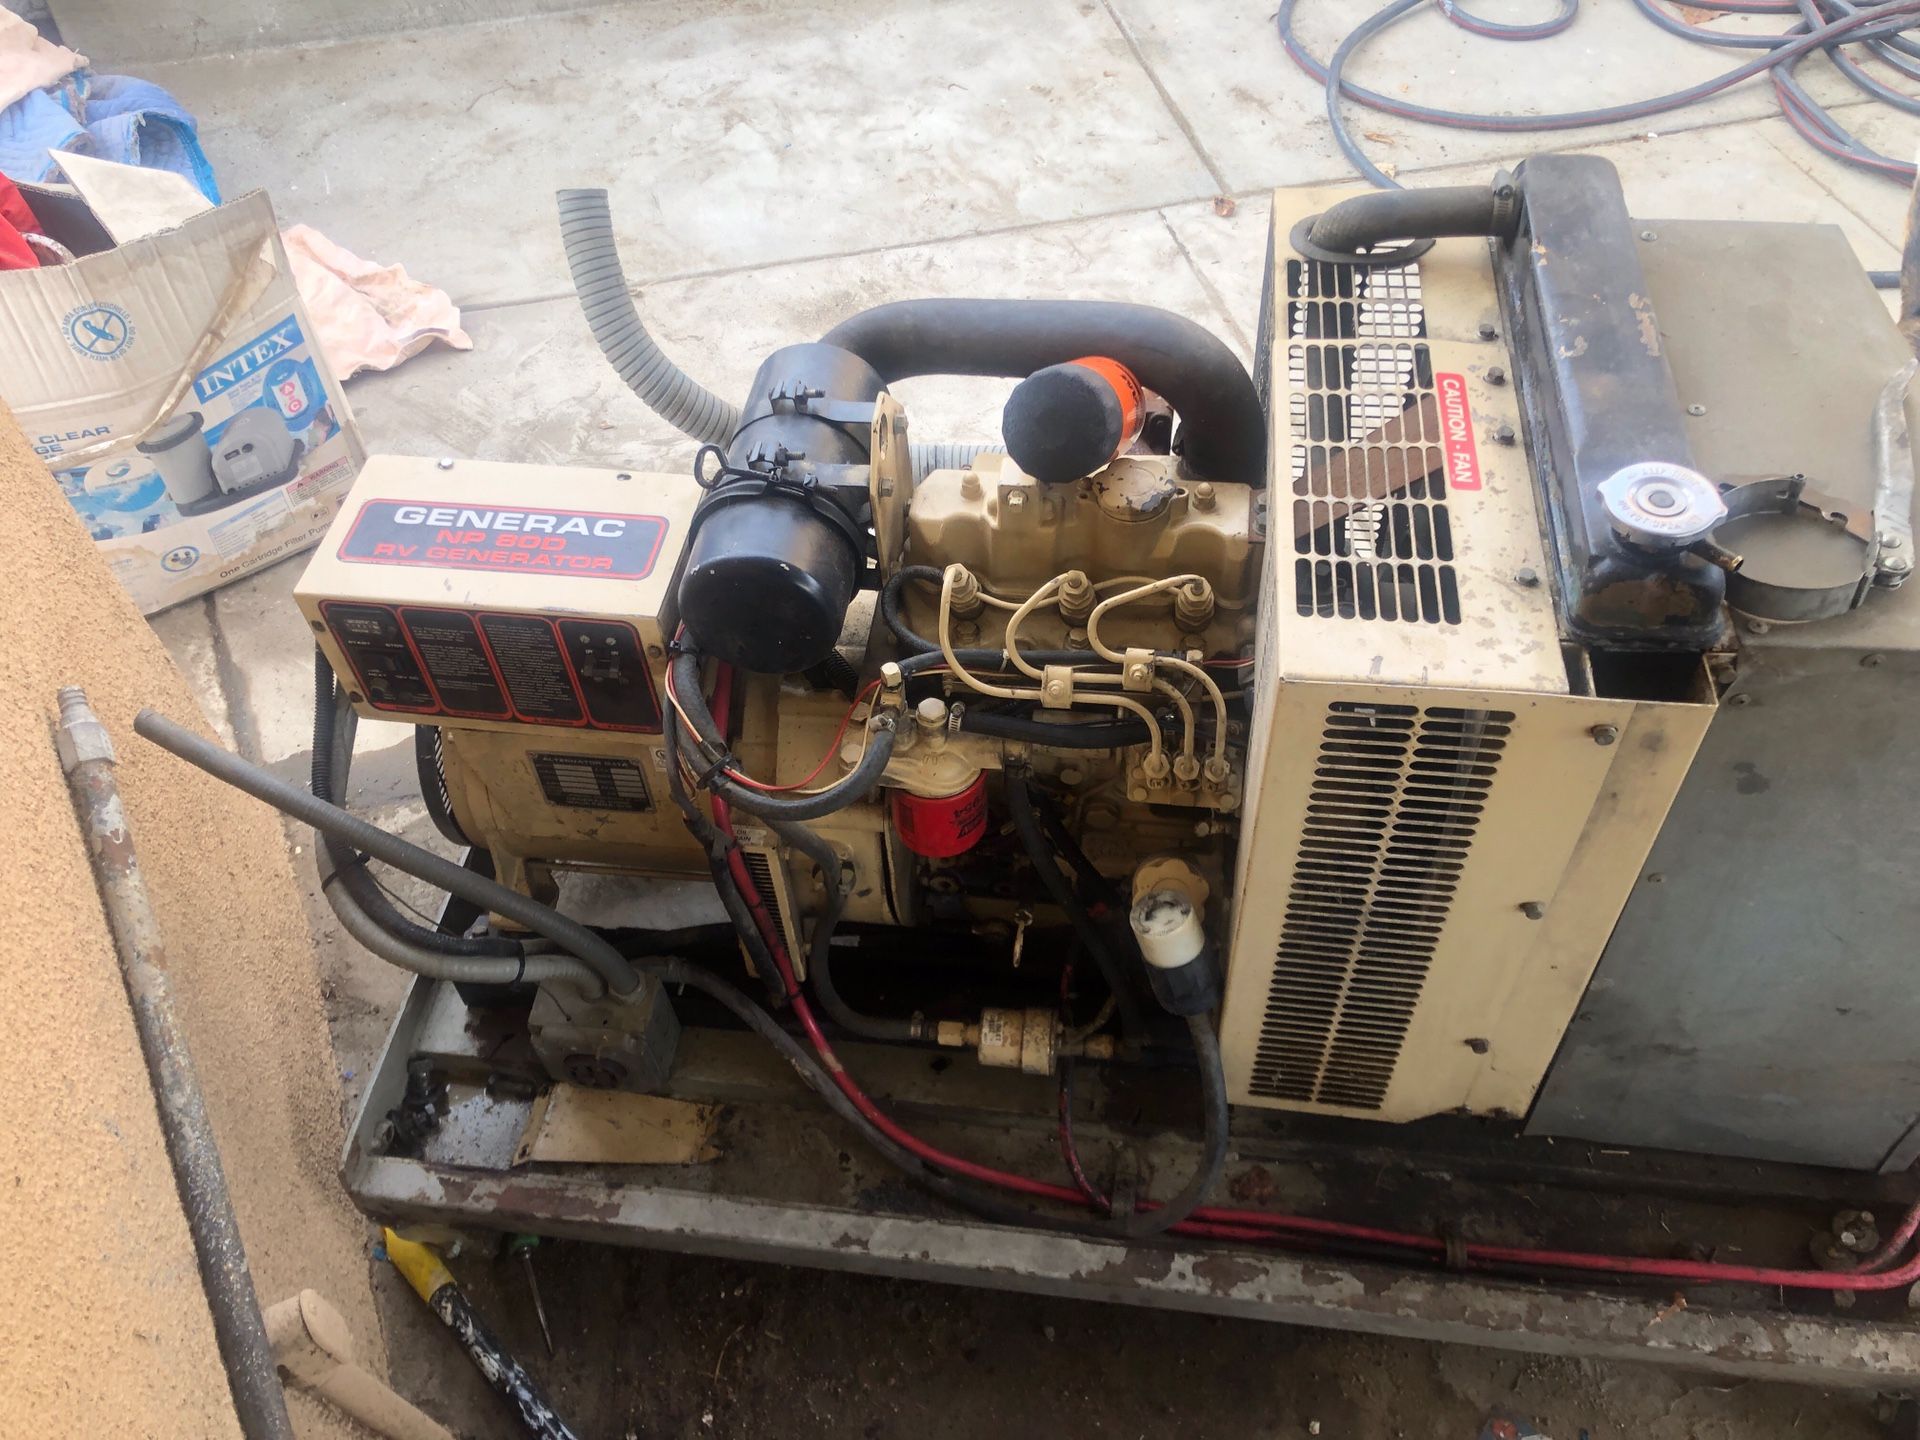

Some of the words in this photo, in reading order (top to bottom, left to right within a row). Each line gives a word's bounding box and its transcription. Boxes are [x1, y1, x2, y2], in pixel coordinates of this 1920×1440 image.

[198, 326, 296, 399] INTEX
[1442, 378, 1467, 442] CAUTION
[39, 426, 111, 444] CLEAR
[1453, 452, 1473, 484] FAN
[393, 505, 626, 538] GENERAC
[435, 529, 487, 545] NP
[219, 564, 241, 579] One
[241, 541, 283, 571] Cartridge
[284, 528, 307, 547] Filter
[373, 542, 417, 557] RV
[426, 546, 613, 570] GENERATOR
